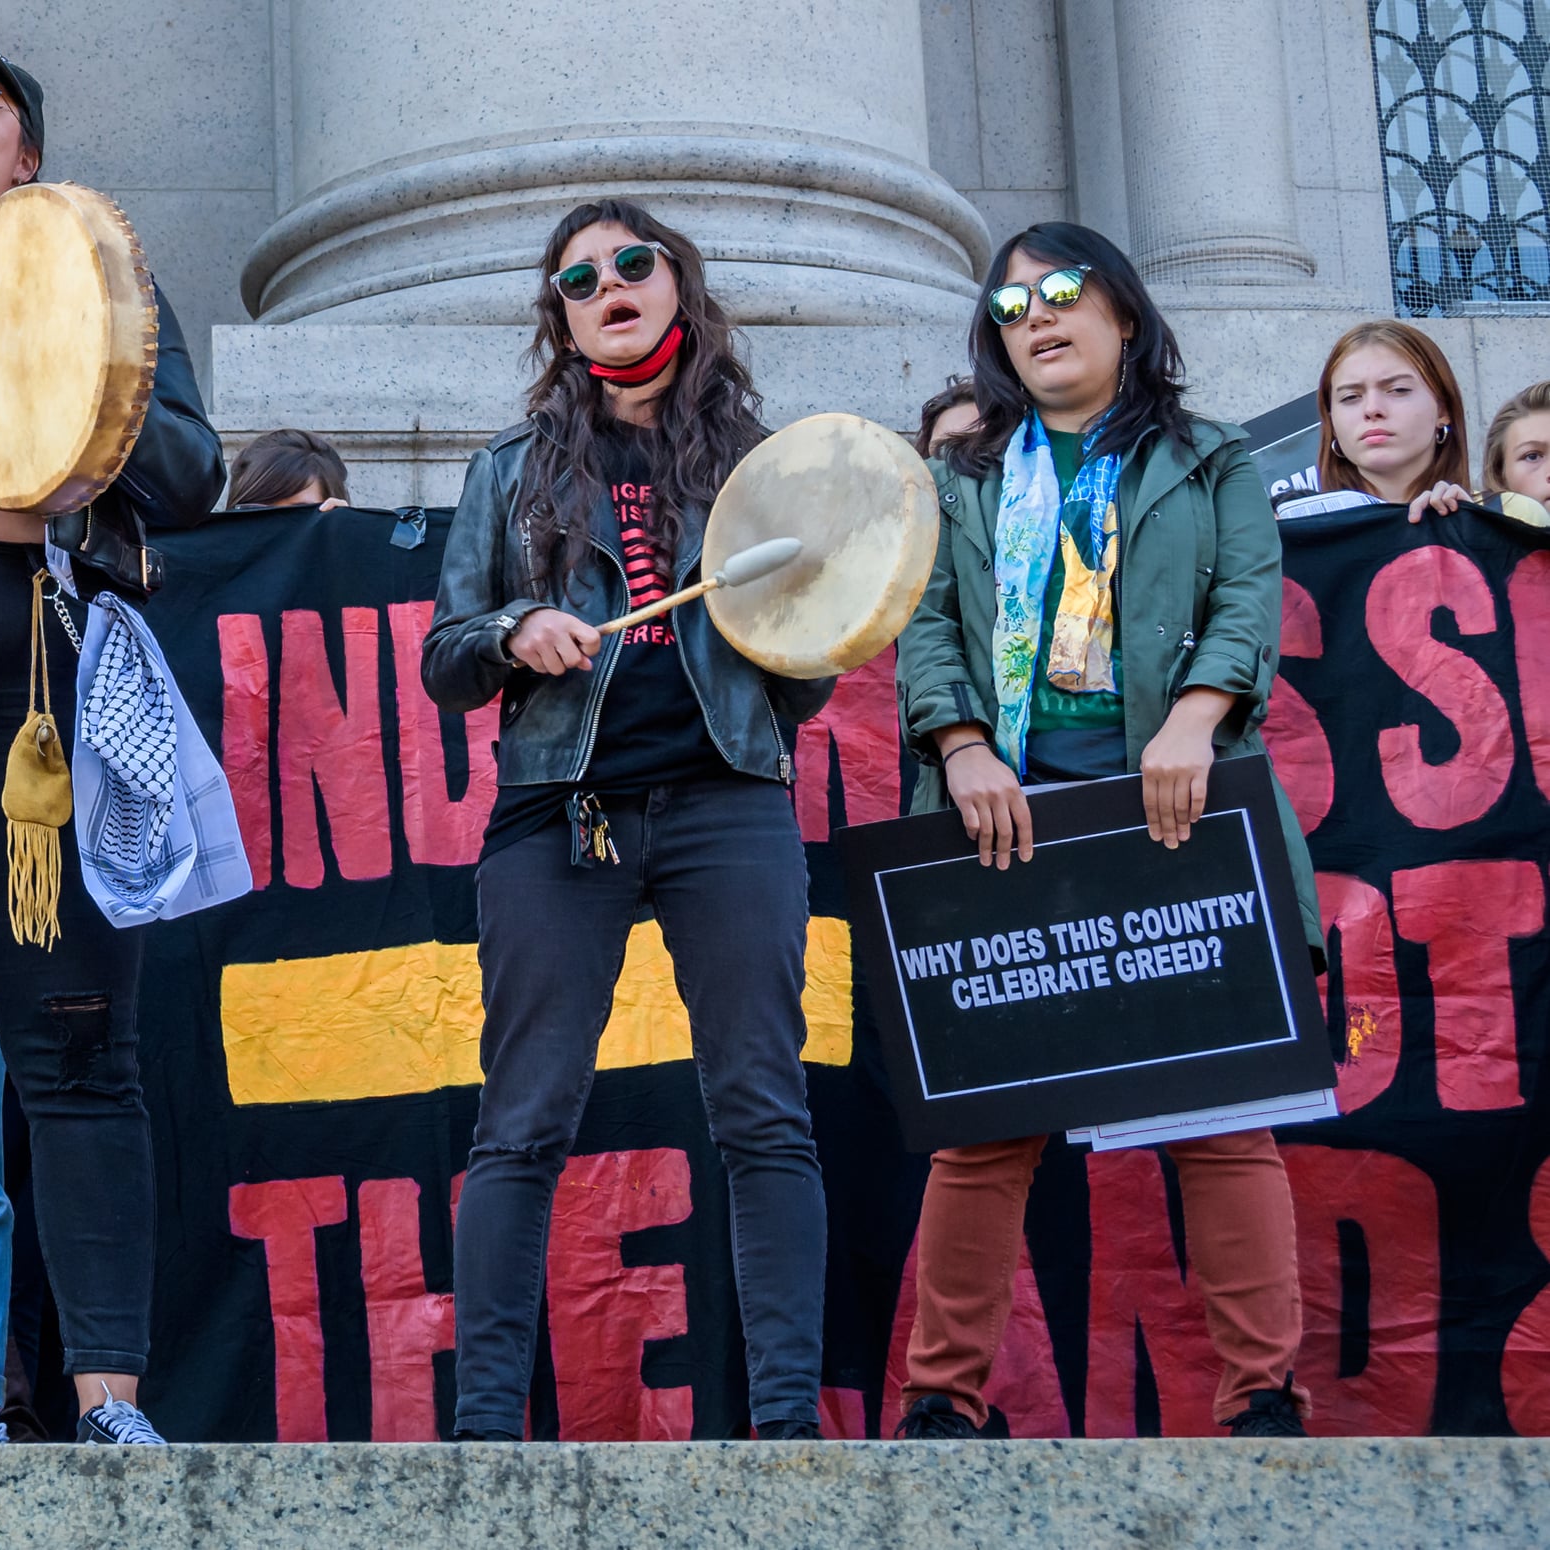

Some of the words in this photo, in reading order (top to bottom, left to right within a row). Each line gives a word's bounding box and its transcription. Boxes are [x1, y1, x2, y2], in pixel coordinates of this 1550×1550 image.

[901, 941, 963, 980] WHY
[971, 928, 1046, 969] DOES
[1049, 915, 1118, 955] THIS
[1123, 891, 1255, 941] COUNTRY
[951, 956, 1111, 1010] CELEBRATE
[1115, 935, 1224, 983] GREED?
[229, 1148, 693, 1441] THE
